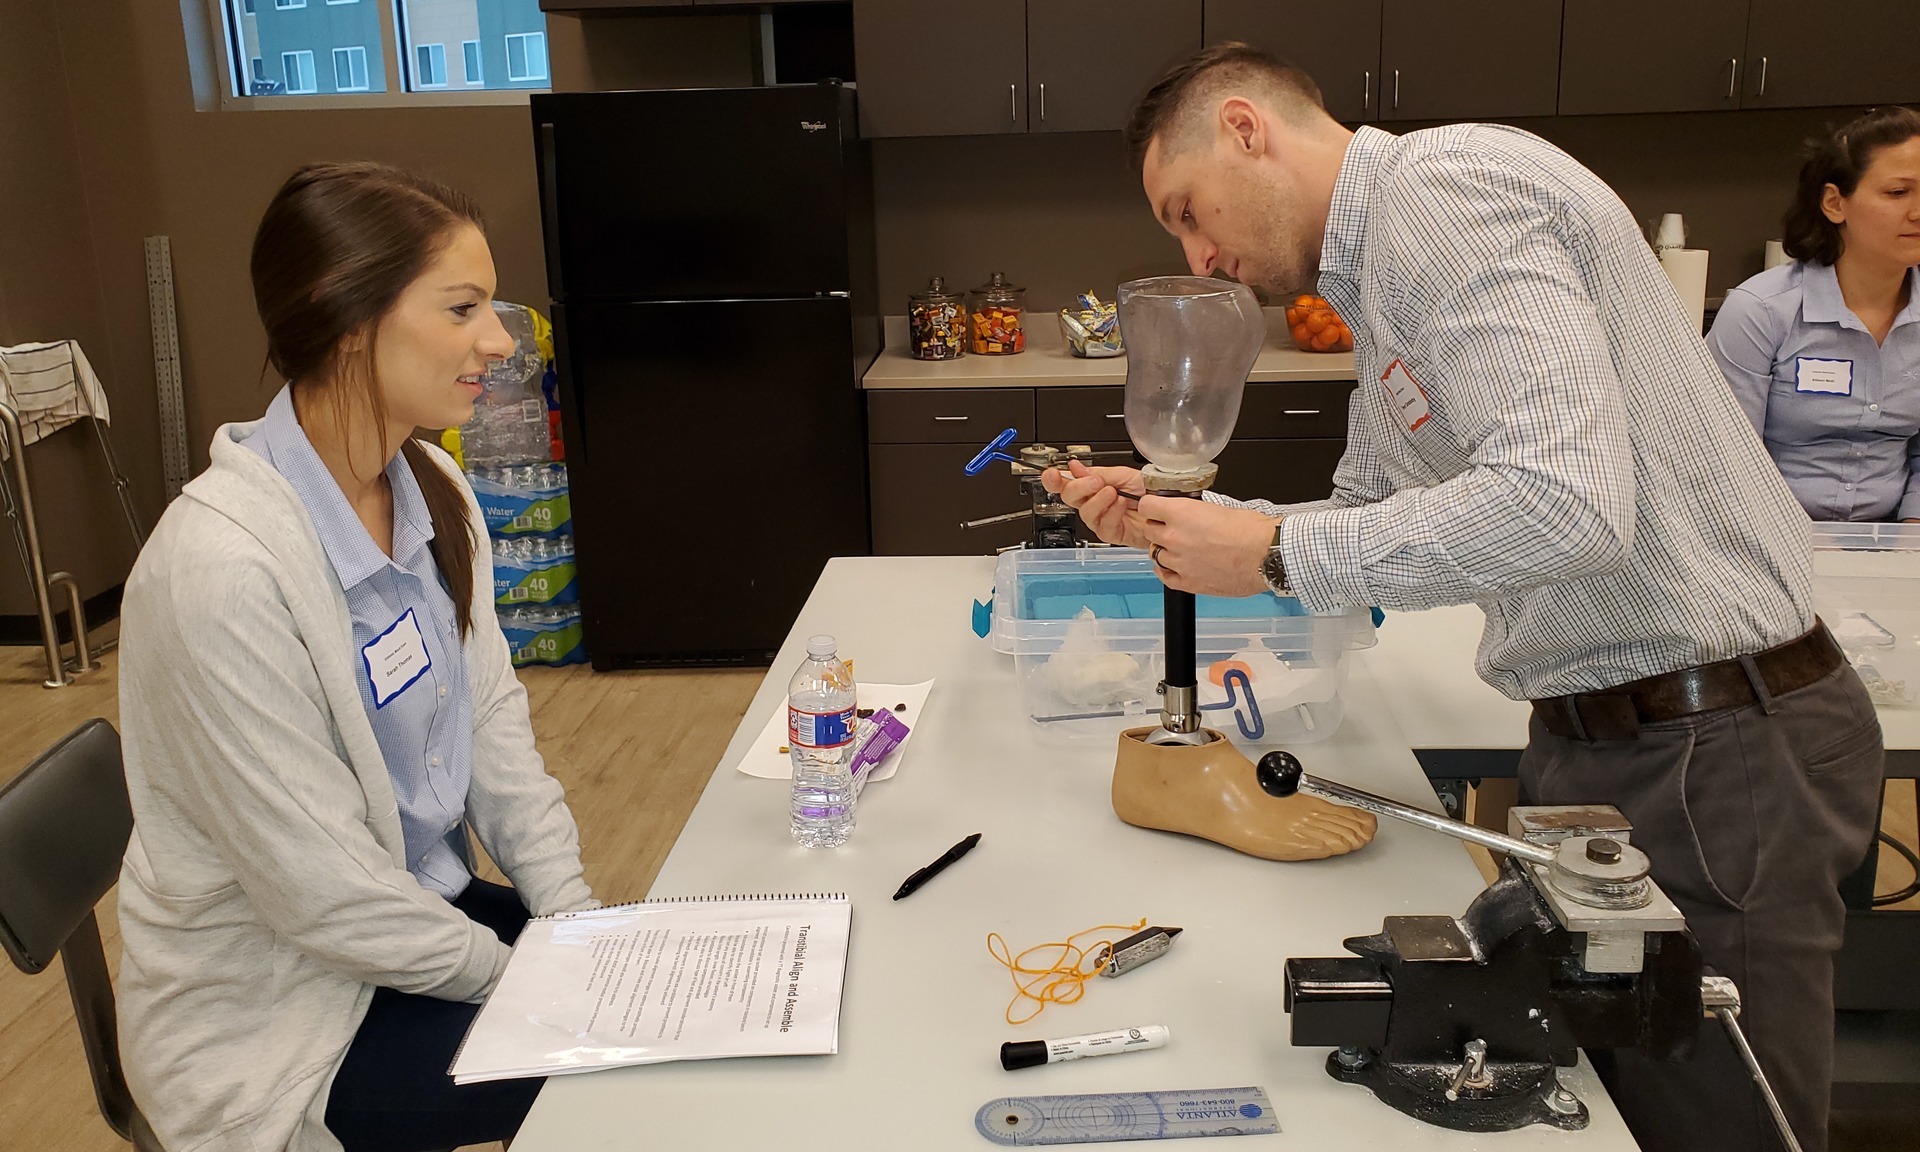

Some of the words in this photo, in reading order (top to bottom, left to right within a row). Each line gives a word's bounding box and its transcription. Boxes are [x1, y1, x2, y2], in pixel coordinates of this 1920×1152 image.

[487, 507, 515, 516] Water
[534, 507, 551, 520] 40
[530, 578, 548, 591] 40
[538, 639, 556, 651] 40
[386, 666, 399, 677] Sarah
[398, 654, 413, 668] Thomas
[794, 925, 810, 959] Transtibial
[789, 962, 803, 981] Align
[788, 983, 799, 996] and
[780, 999, 797, 1033] Assemble
[1176, 1109, 1237, 1119] ATLANTA
